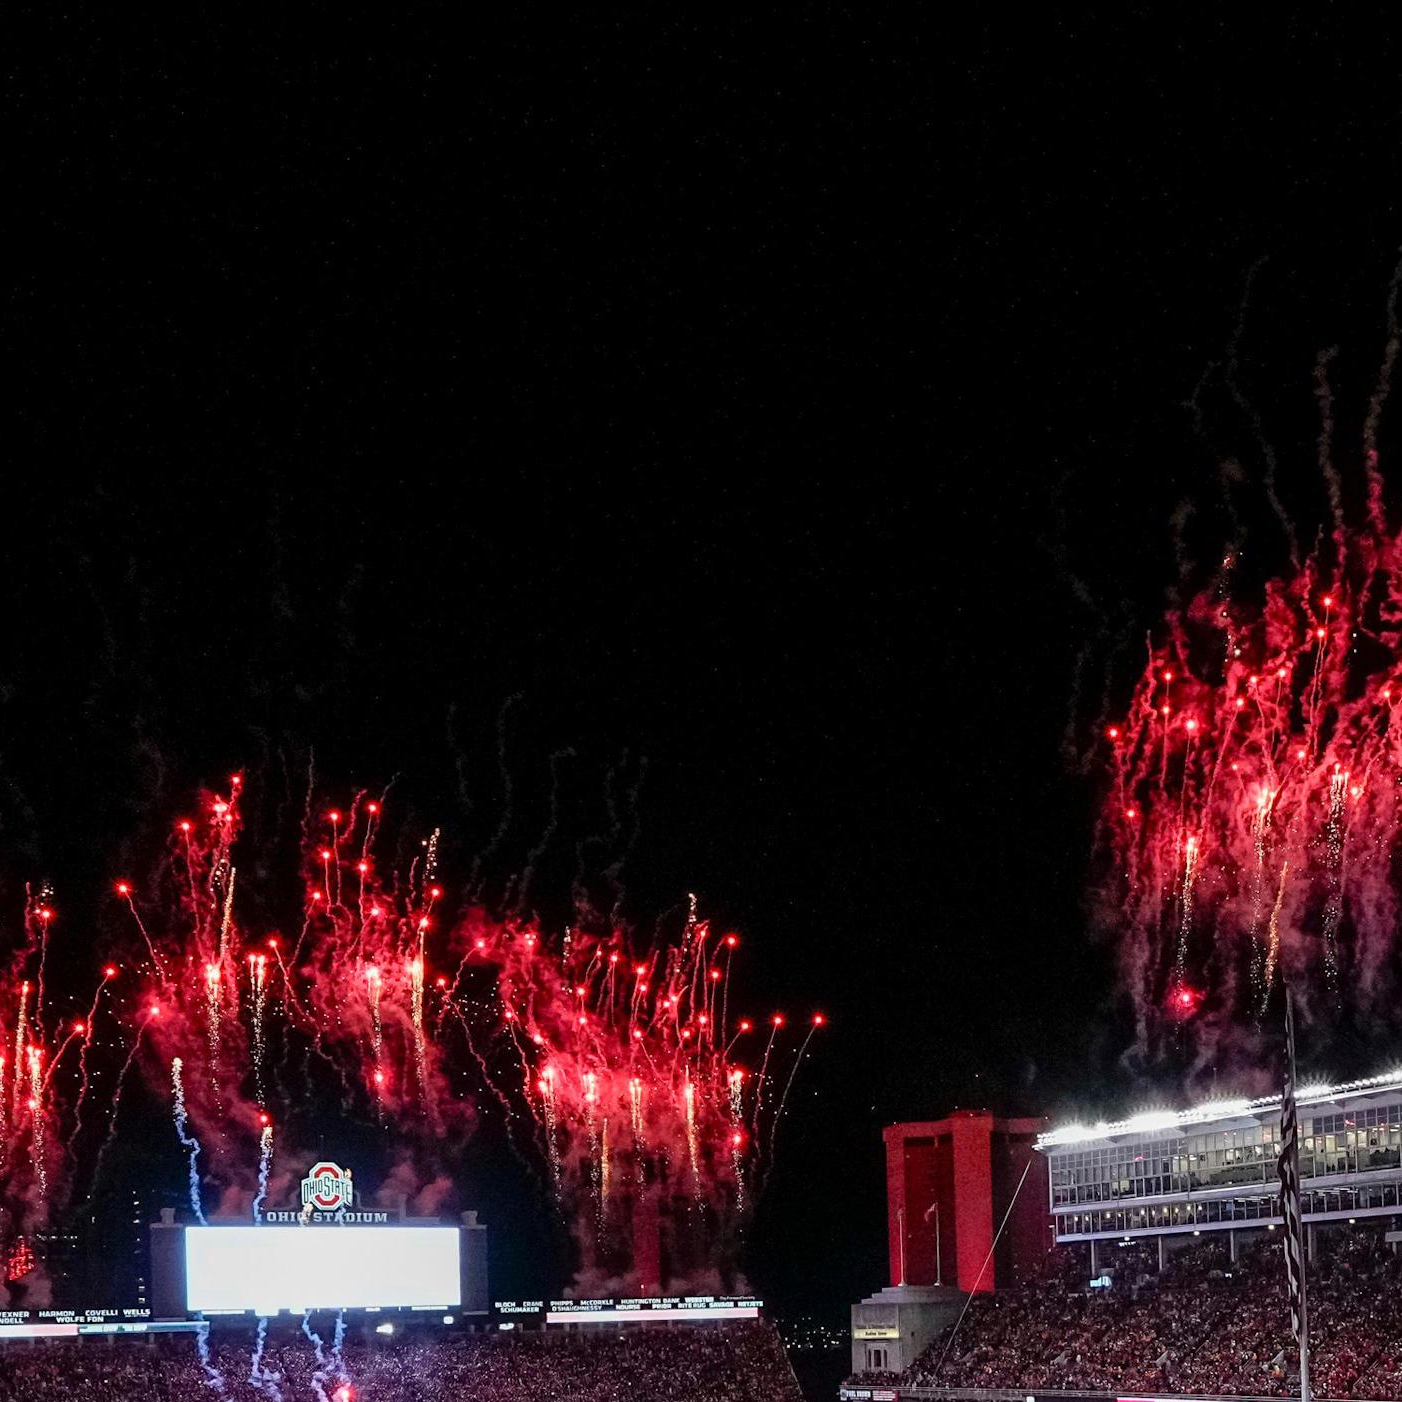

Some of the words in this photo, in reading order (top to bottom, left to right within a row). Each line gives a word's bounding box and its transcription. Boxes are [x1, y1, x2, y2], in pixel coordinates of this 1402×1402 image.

[302, 1180, 323, 1203] OHIO
[313, 1211, 388, 1223] STADIUM
[85, 1309, 118, 1317] COVELLI
[123, 1308, 151, 1316] WELLS
